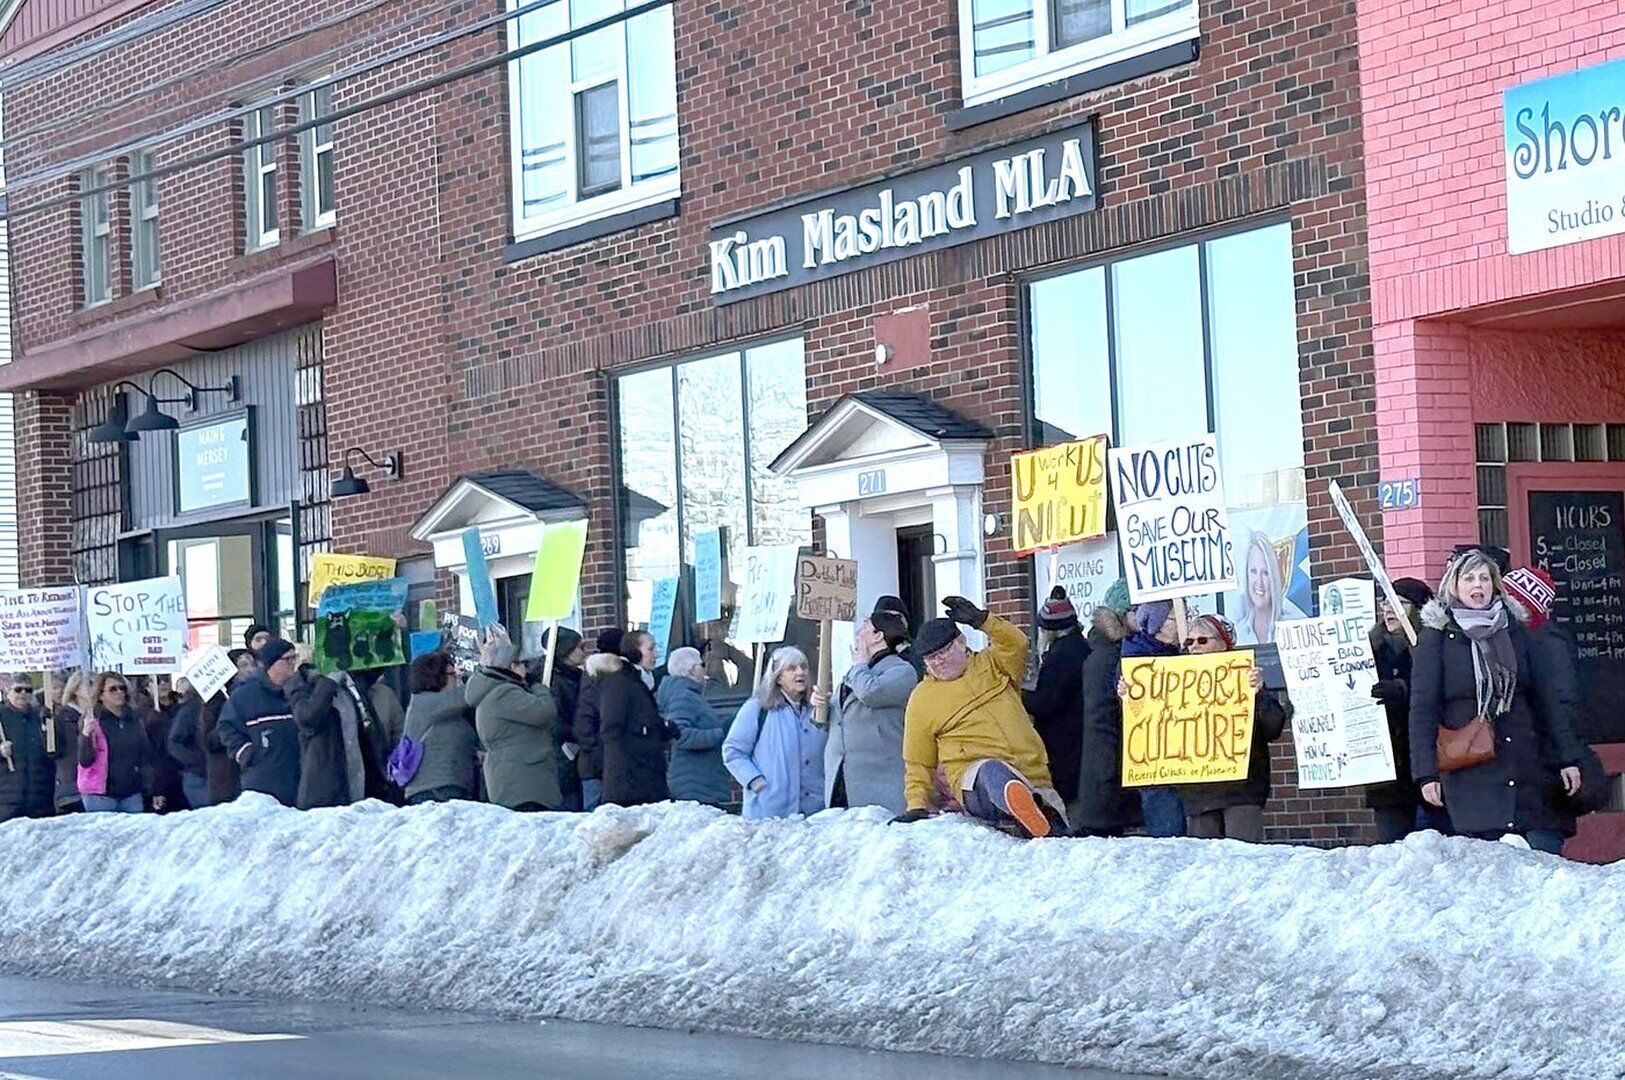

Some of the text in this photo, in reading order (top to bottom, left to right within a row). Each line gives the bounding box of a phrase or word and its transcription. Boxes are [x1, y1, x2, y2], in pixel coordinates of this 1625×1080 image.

[1514, 101, 1625, 179] Shor
[709, 138, 1093, 294] Kim Masland MLA
[1548, 200, 1614, 234] Studio
[861, 471, 886, 495] 271
[1014, 456, 1036, 502] U
[1076, 439, 1104, 487] US
[1048, 472, 1058, 491] 4
[1116, 442, 1217, 503] NO CUTS
[1382, 480, 1414, 508] 275
[1127, 505, 1228, 548] SAVE OUR
[1556, 505, 1611, 531] HOURS
[482, 536, 499, 555] 269
[1566, 535, 1606, 551] Closed
[323, 562, 355, 577] THIS
[1047, 559, 1104, 581] ORKING
[1131, 533, 1236, 590] MUSEUMS
[1565, 554, 1606, 573] Closed
[94, 590, 150, 616] STOP
[155, 593, 186, 613] THE
[112, 615, 168, 636] CUTS
[1338, 646, 1364, 660] BAD
[1130, 658, 1249, 710] SUPPORT
[1128, 706, 1249, 766] CULTURE
